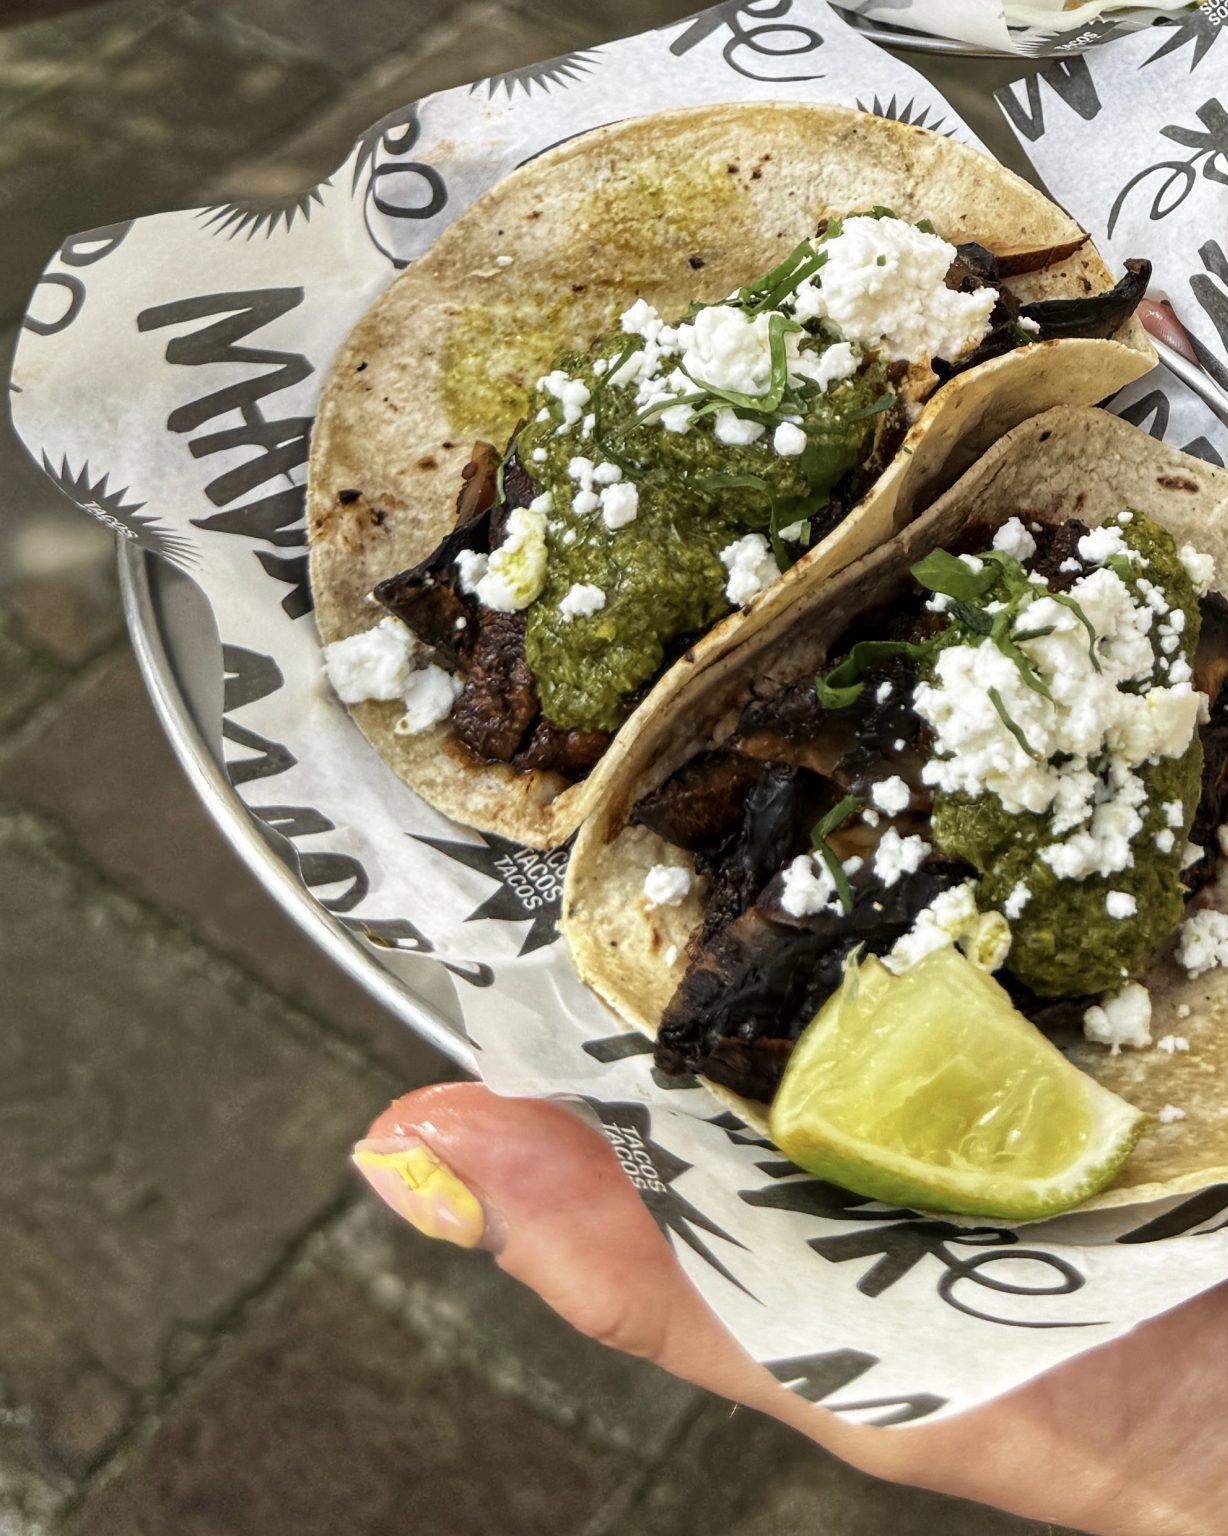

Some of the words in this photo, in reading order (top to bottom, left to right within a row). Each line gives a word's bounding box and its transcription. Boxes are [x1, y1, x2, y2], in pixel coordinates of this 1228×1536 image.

[493, 854, 543, 910] TACOS
[513, 847, 564, 902] TACOS
[601, 1122, 648, 1189] TACOS
[620, 1125, 667, 1193] TACOS
